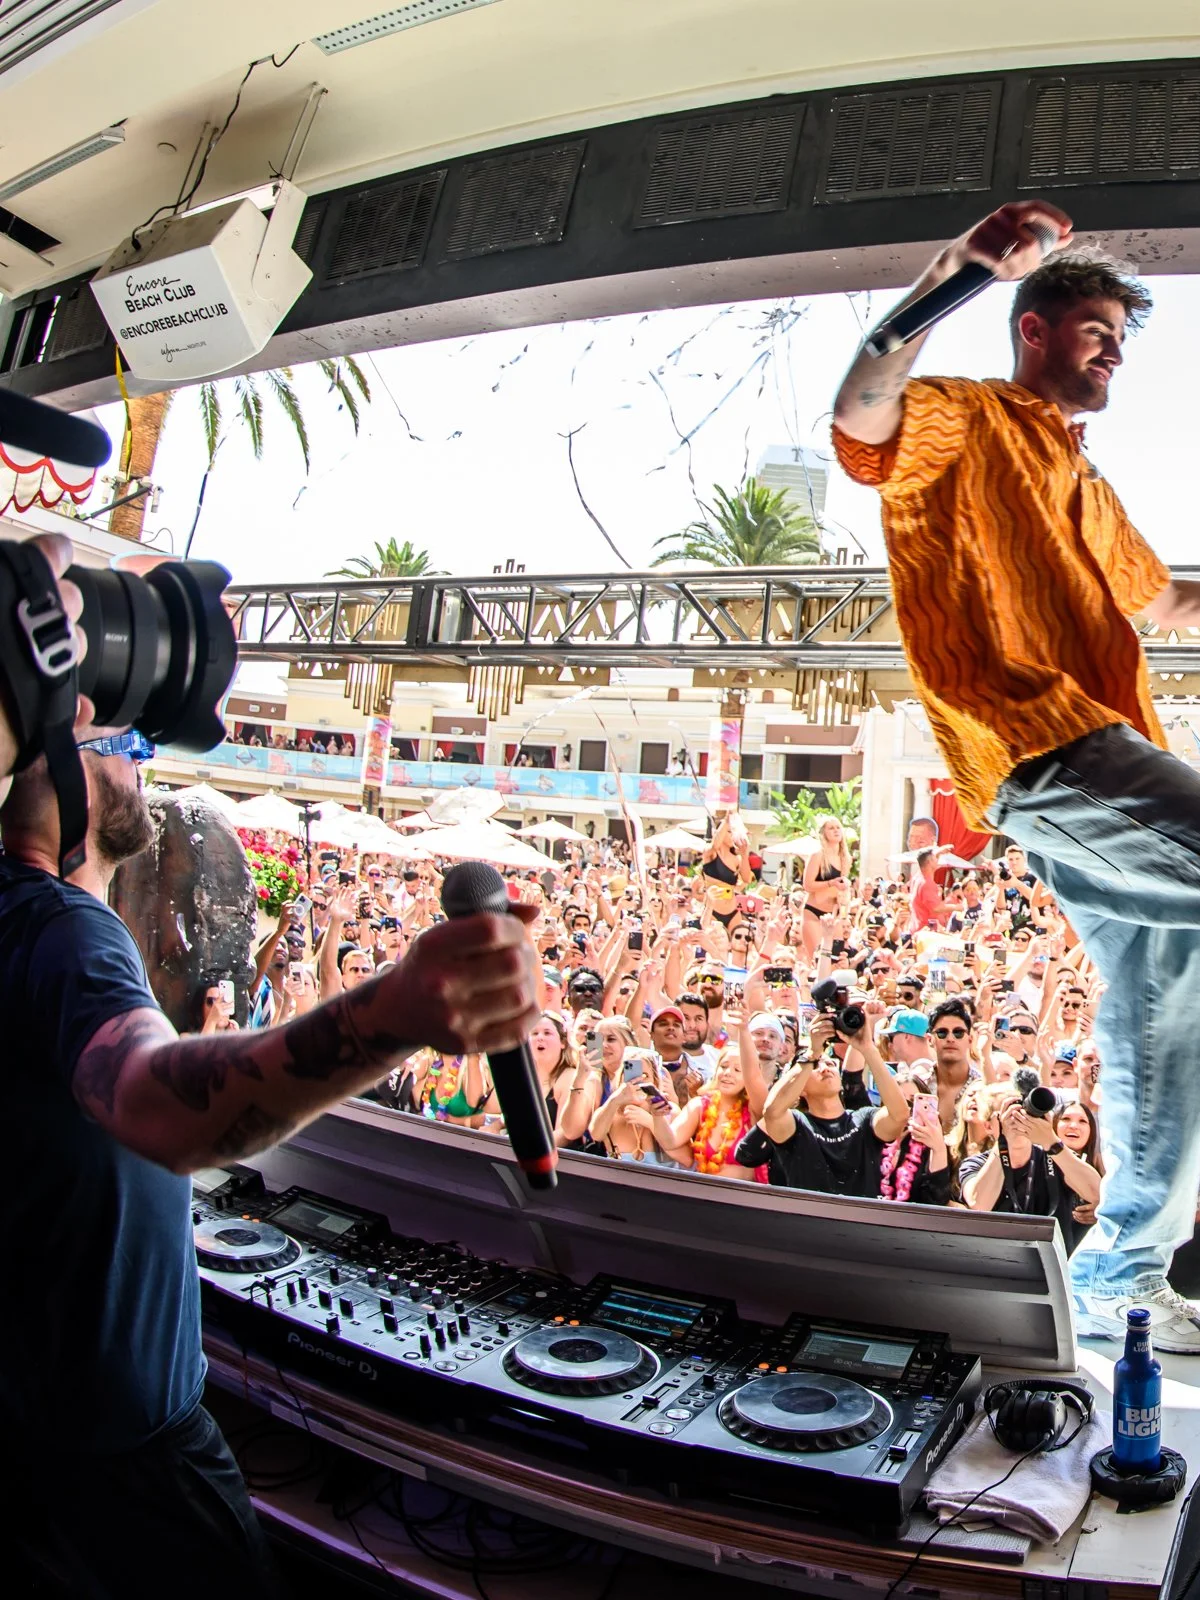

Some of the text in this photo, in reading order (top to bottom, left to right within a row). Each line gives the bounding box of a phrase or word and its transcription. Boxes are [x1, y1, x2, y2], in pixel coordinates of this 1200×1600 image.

[124, 284, 197, 313] BEACH CLUB
[125, 275, 181, 297] Encore
[120, 302, 229, 340] @ENCOREBEACHCLUB
[287, 1331, 355, 1368] Pioneer
[1117, 1421, 1161, 1437] LIGH
